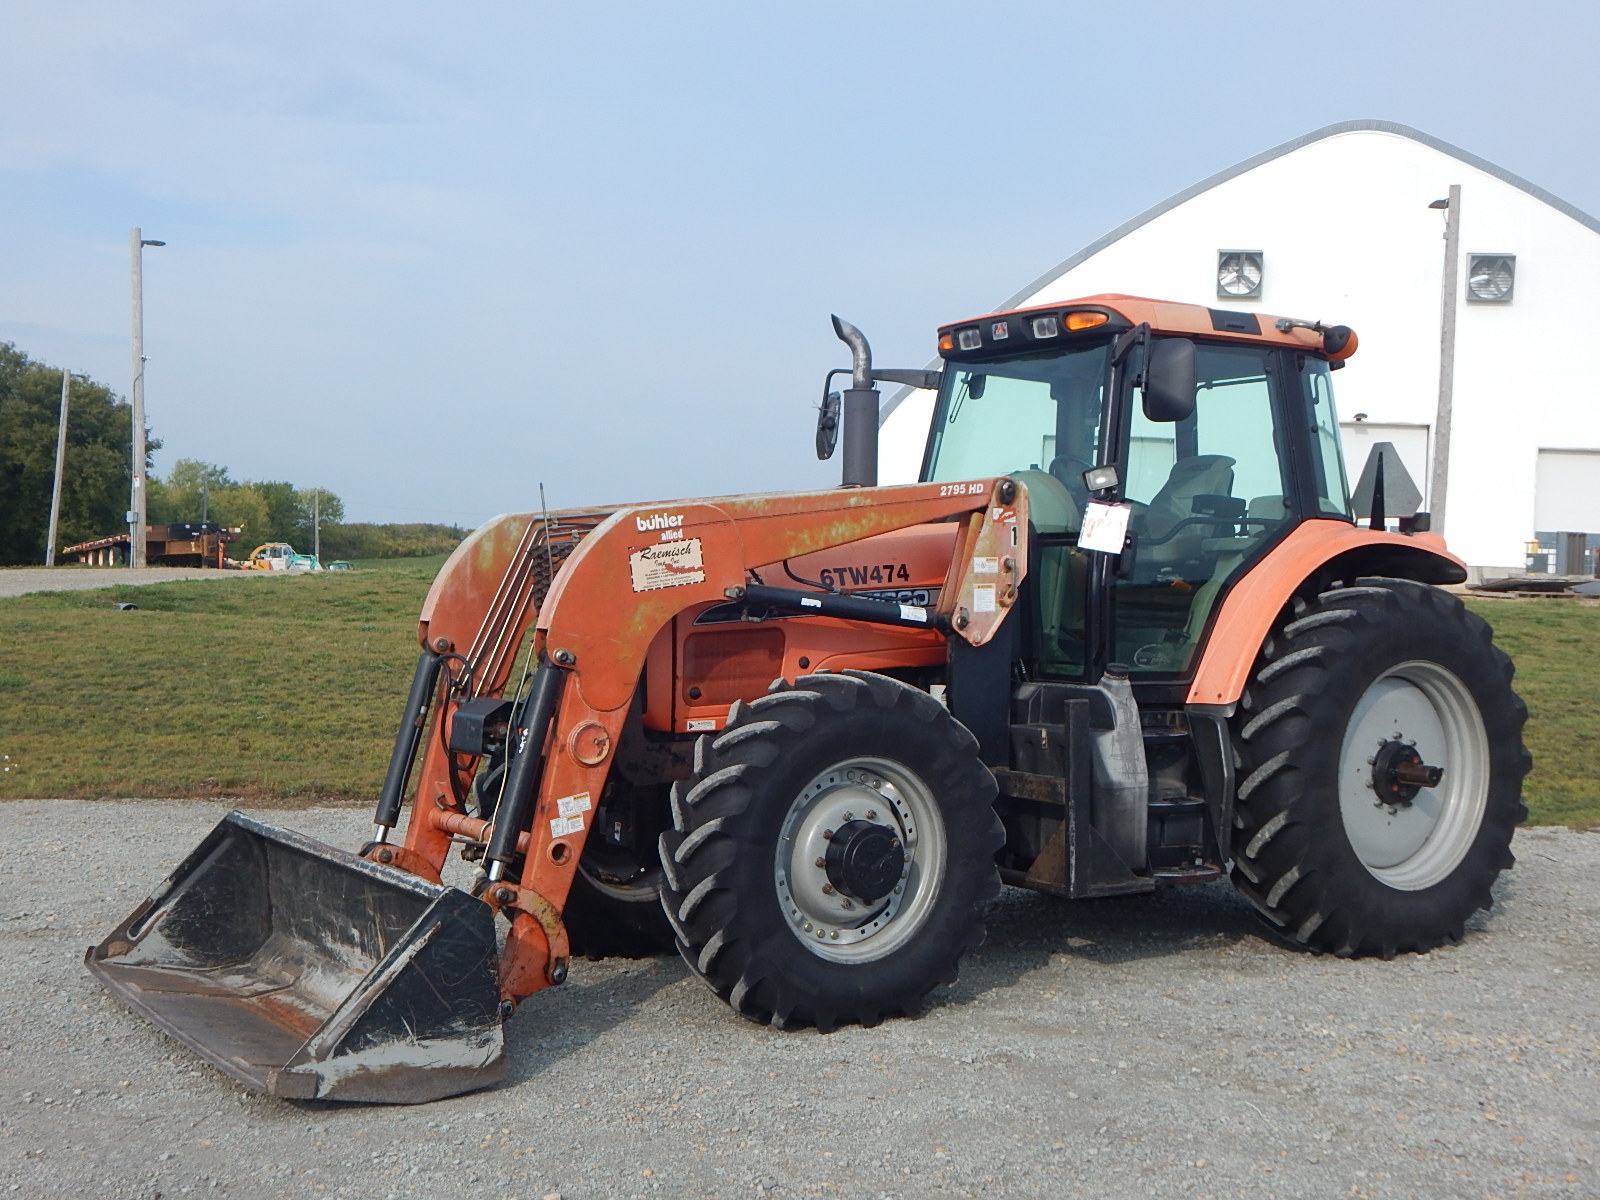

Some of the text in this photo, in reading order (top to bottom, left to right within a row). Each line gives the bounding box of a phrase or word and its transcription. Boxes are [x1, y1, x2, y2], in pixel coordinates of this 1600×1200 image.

[940, 483, 984, 496] 2795 HD
[660, 528, 683, 541] allied
[639, 541, 692, 562] Raemisch
[819, 563, 910, 588] 6TW474
